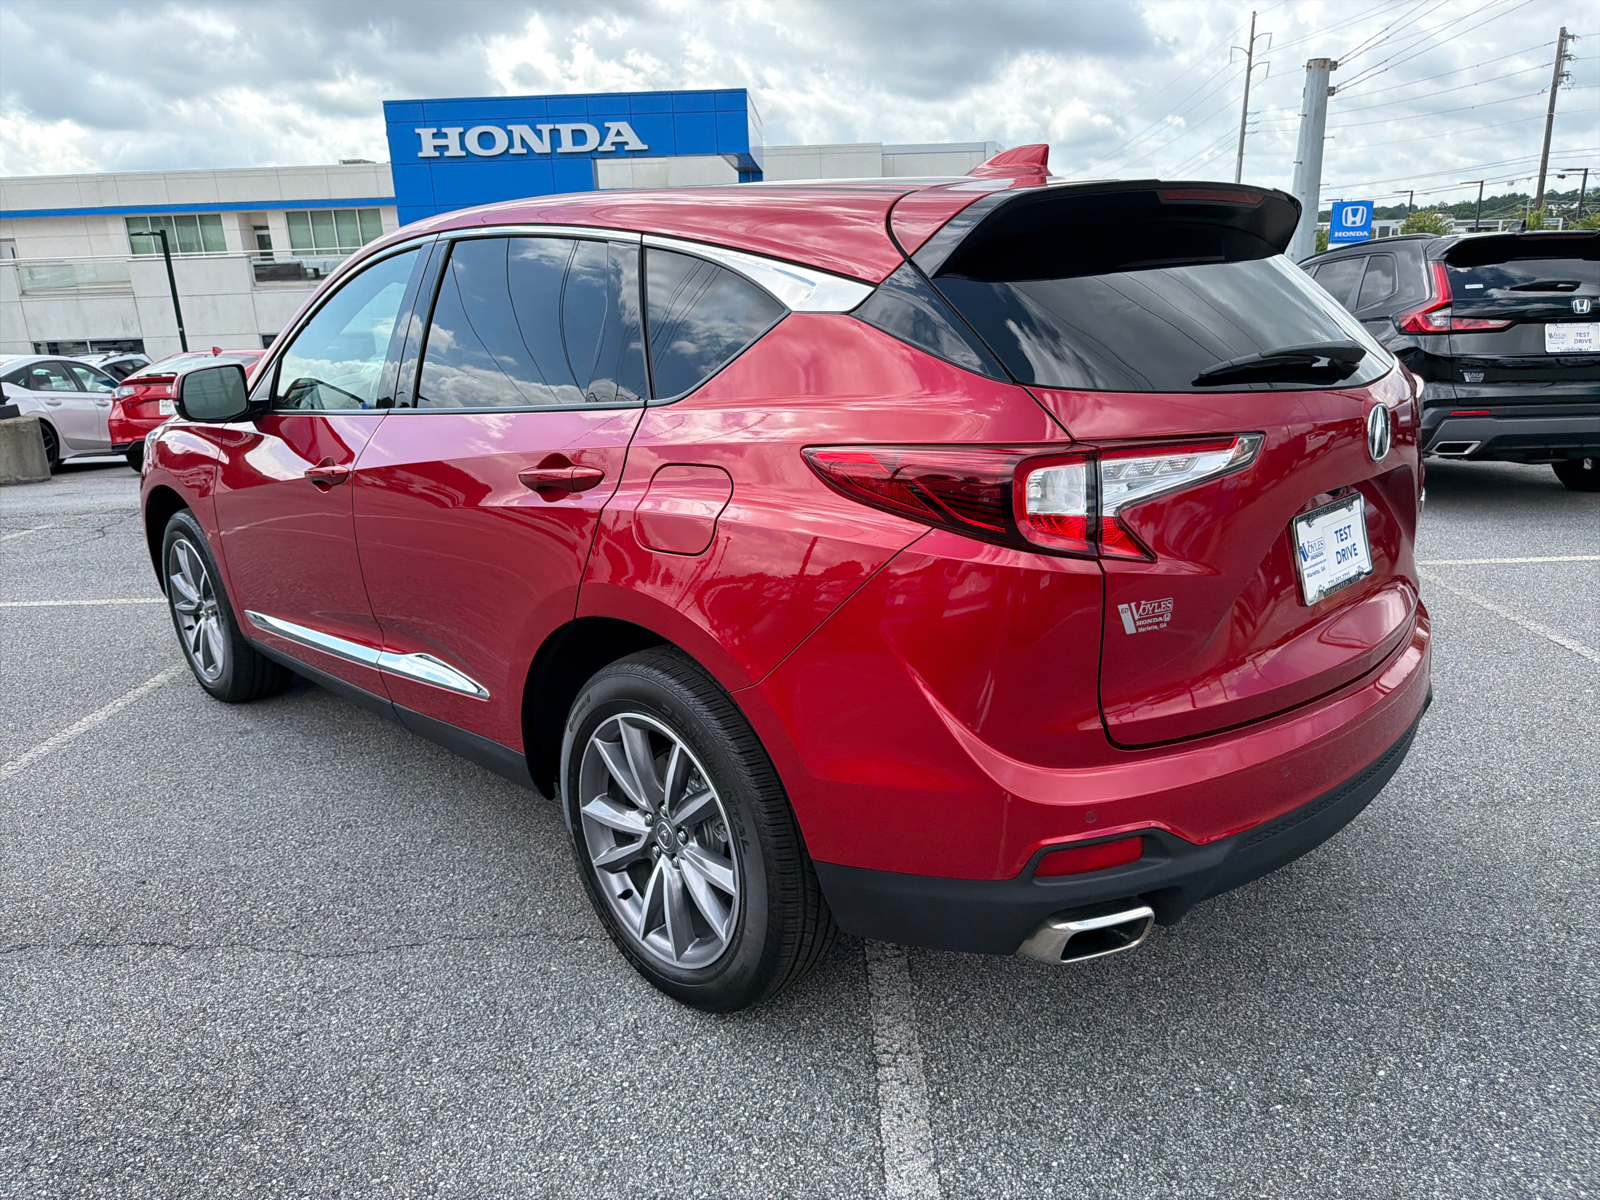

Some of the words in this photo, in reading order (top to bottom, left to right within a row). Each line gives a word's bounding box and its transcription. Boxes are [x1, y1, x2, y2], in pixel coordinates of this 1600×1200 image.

[415, 121, 649, 158] HONDA
[1334, 525, 1352, 544] TEST
[1336, 543, 1358, 565] DRIVE
[1130, 600, 1172, 621] VOYLES
[1136, 616, 1163, 626] HONDA
